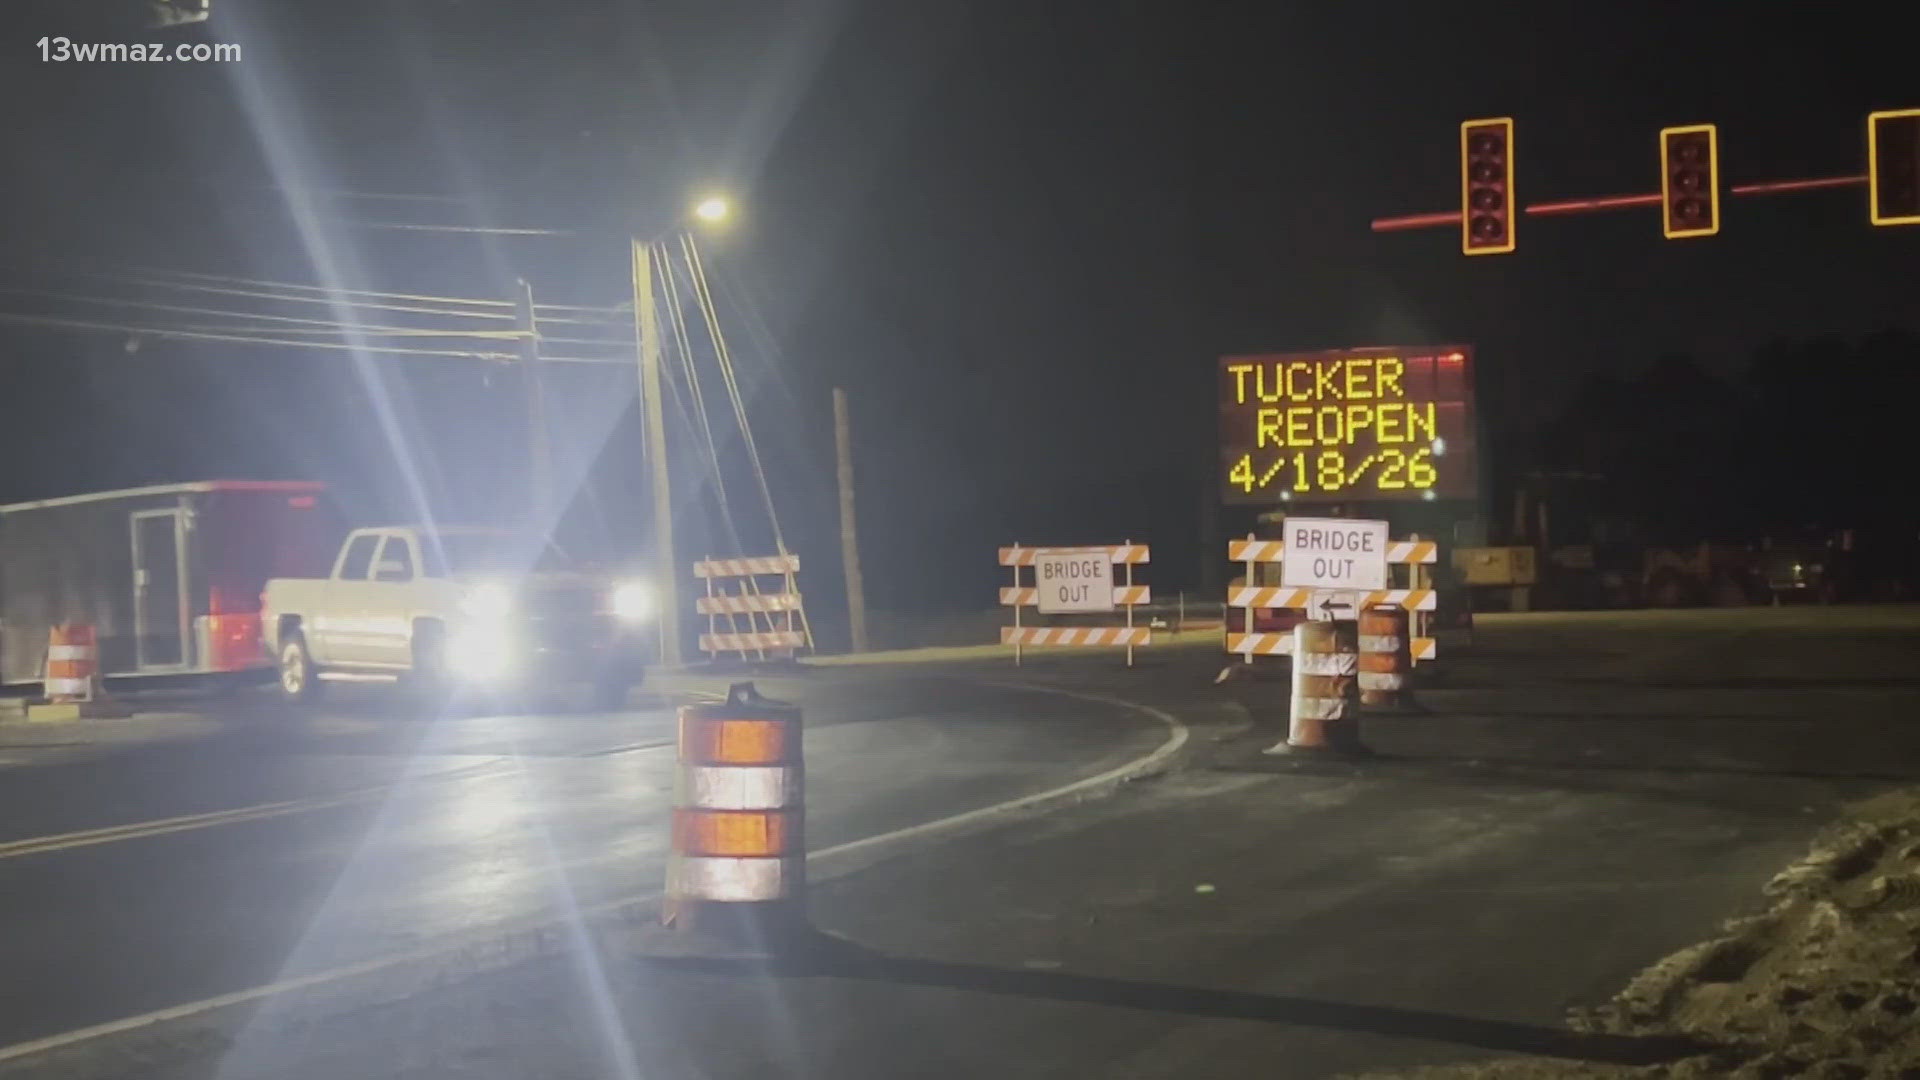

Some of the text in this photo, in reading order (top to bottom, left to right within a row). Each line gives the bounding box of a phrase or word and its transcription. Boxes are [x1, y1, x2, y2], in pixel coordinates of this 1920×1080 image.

[1228, 357, 1404, 404] TUCKER
[1257, 402, 1435, 448] REOPEN
[1229, 448, 1437, 493] 4/18/26
[1295, 528, 1374, 553] BRIDGE
[1043, 560, 1103, 580] BRIDGE
[1313, 558, 1355, 580] OUT
[1058, 584, 1090, 604] OUT
